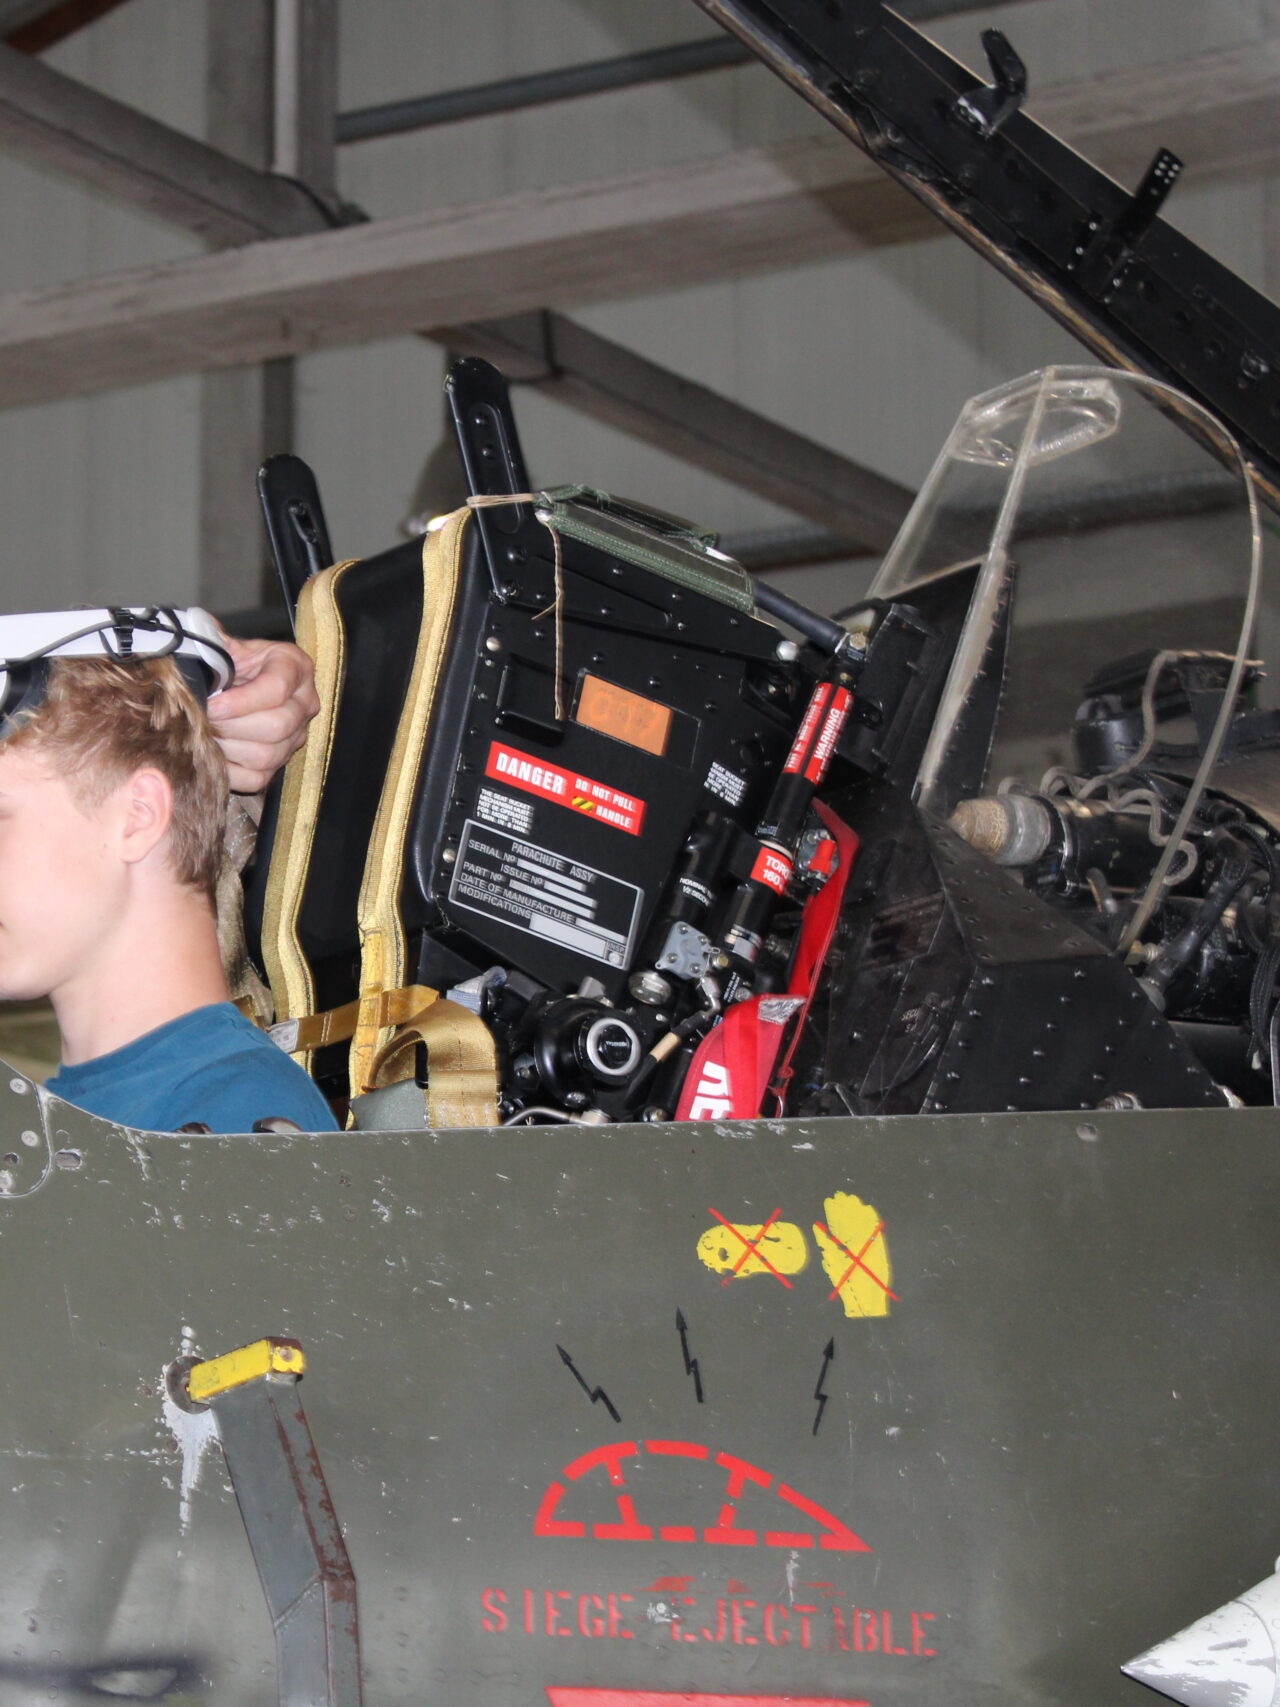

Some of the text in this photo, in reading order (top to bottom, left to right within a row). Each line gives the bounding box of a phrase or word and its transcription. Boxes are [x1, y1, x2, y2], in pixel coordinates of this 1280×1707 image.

[813, 707, 840, 759] WARNING
[496, 752, 636, 812] DANGER DO NOT PULL
[479, 799, 492, 809] NOT
[500, 807, 532, 823] OPERATED
[480, 794, 533, 817] MECHANISM MUST
[481, 788, 533, 811] THE SEAT BUCKET
[477, 805, 531, 829] FOR MORE THAN
[596, 804, 633, 829] HANDLE
[468, 839, 500, 860] SERIAL
[463, 861, 486, 877] PART
[501, 864, 530, 880] ISSUE
[512, 842, 596, 883] PARACHUTE ASSY
[458, 884, 532, 919] MODIFICATIONS
[461, 873, 486, 889] DATE
[487, 882, 502, 894] OF
[503, 887, 575, 923] MANUFACTURE
[480, 1588, 939, 1657] SIEGE EJECTABLE
